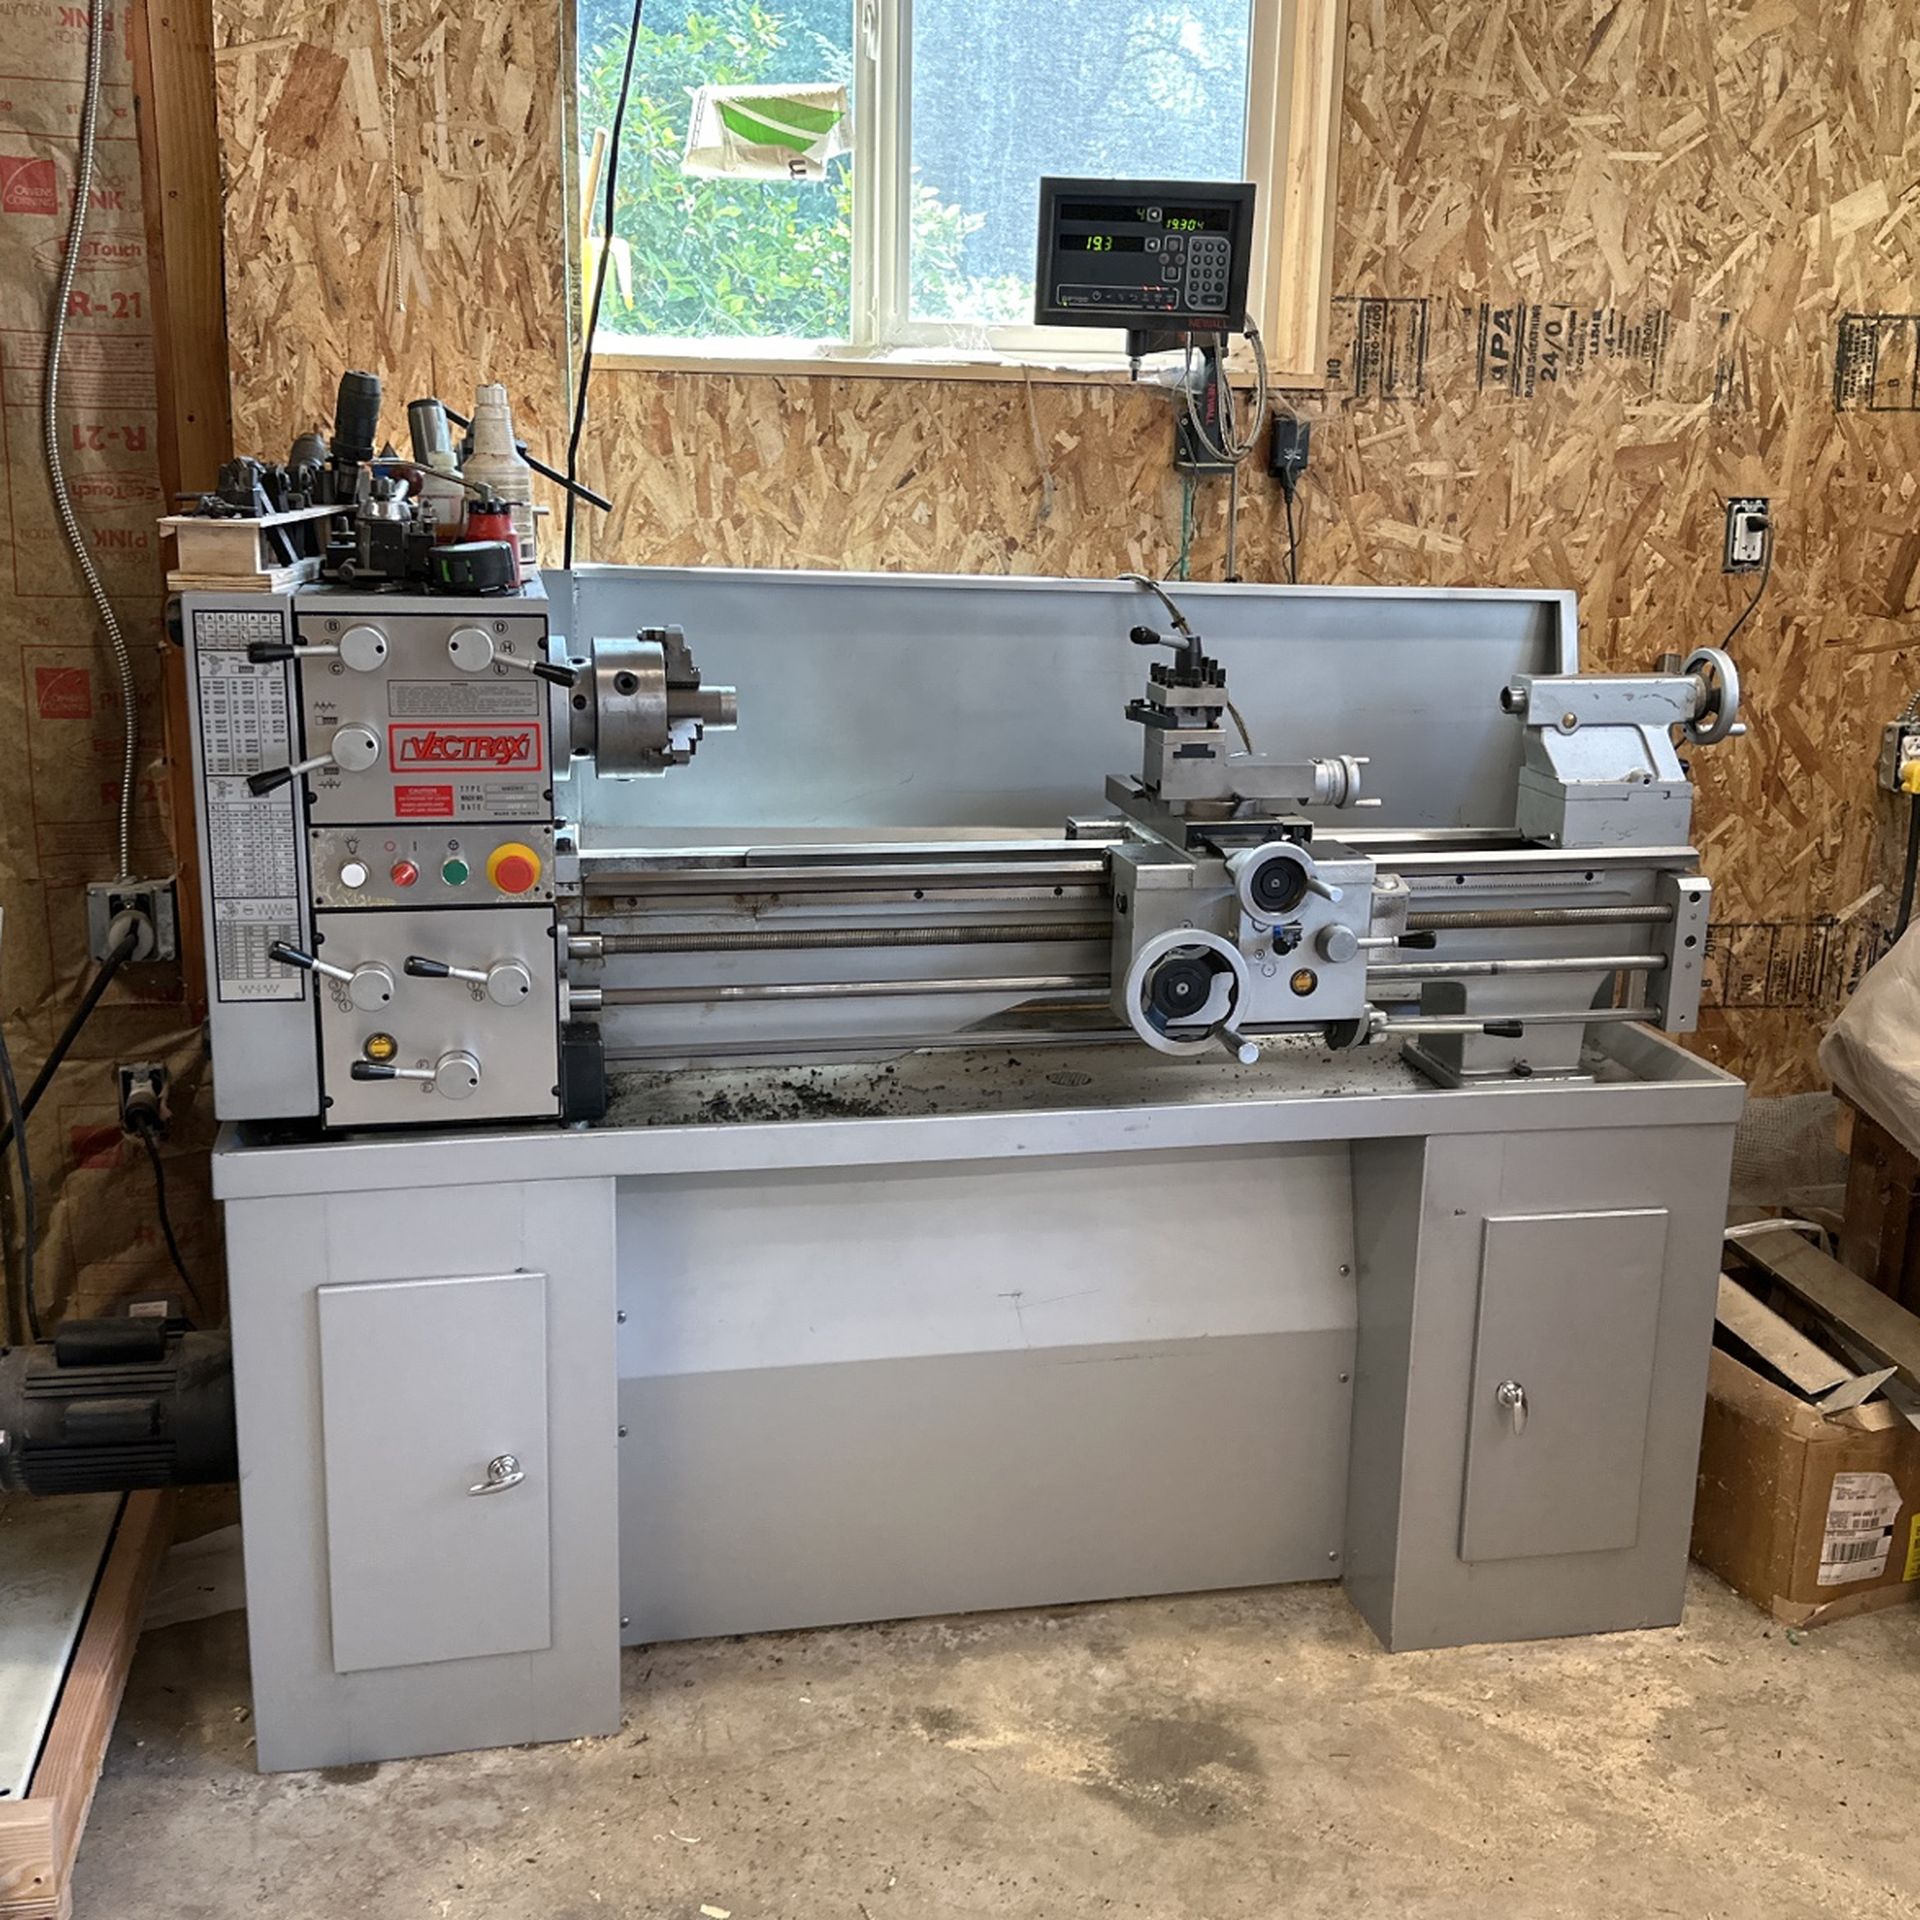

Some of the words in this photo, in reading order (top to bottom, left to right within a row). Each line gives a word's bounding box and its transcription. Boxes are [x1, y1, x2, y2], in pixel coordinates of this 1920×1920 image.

[58, 6, 114, 32] PNK
[67, 291, 142, 319] R-21
[1490, 308, 1513, 381] APA
[1528, 305, 1541, 363] SHEATHING
[1540, 321, 1564, 382] 24/0
[1525, 365, 1536, 398] RATED
[72, 425, 146, 452] R-21
[92, 530, 148, 548] PINK
[410, 731, 529, 765] VECTRAX
